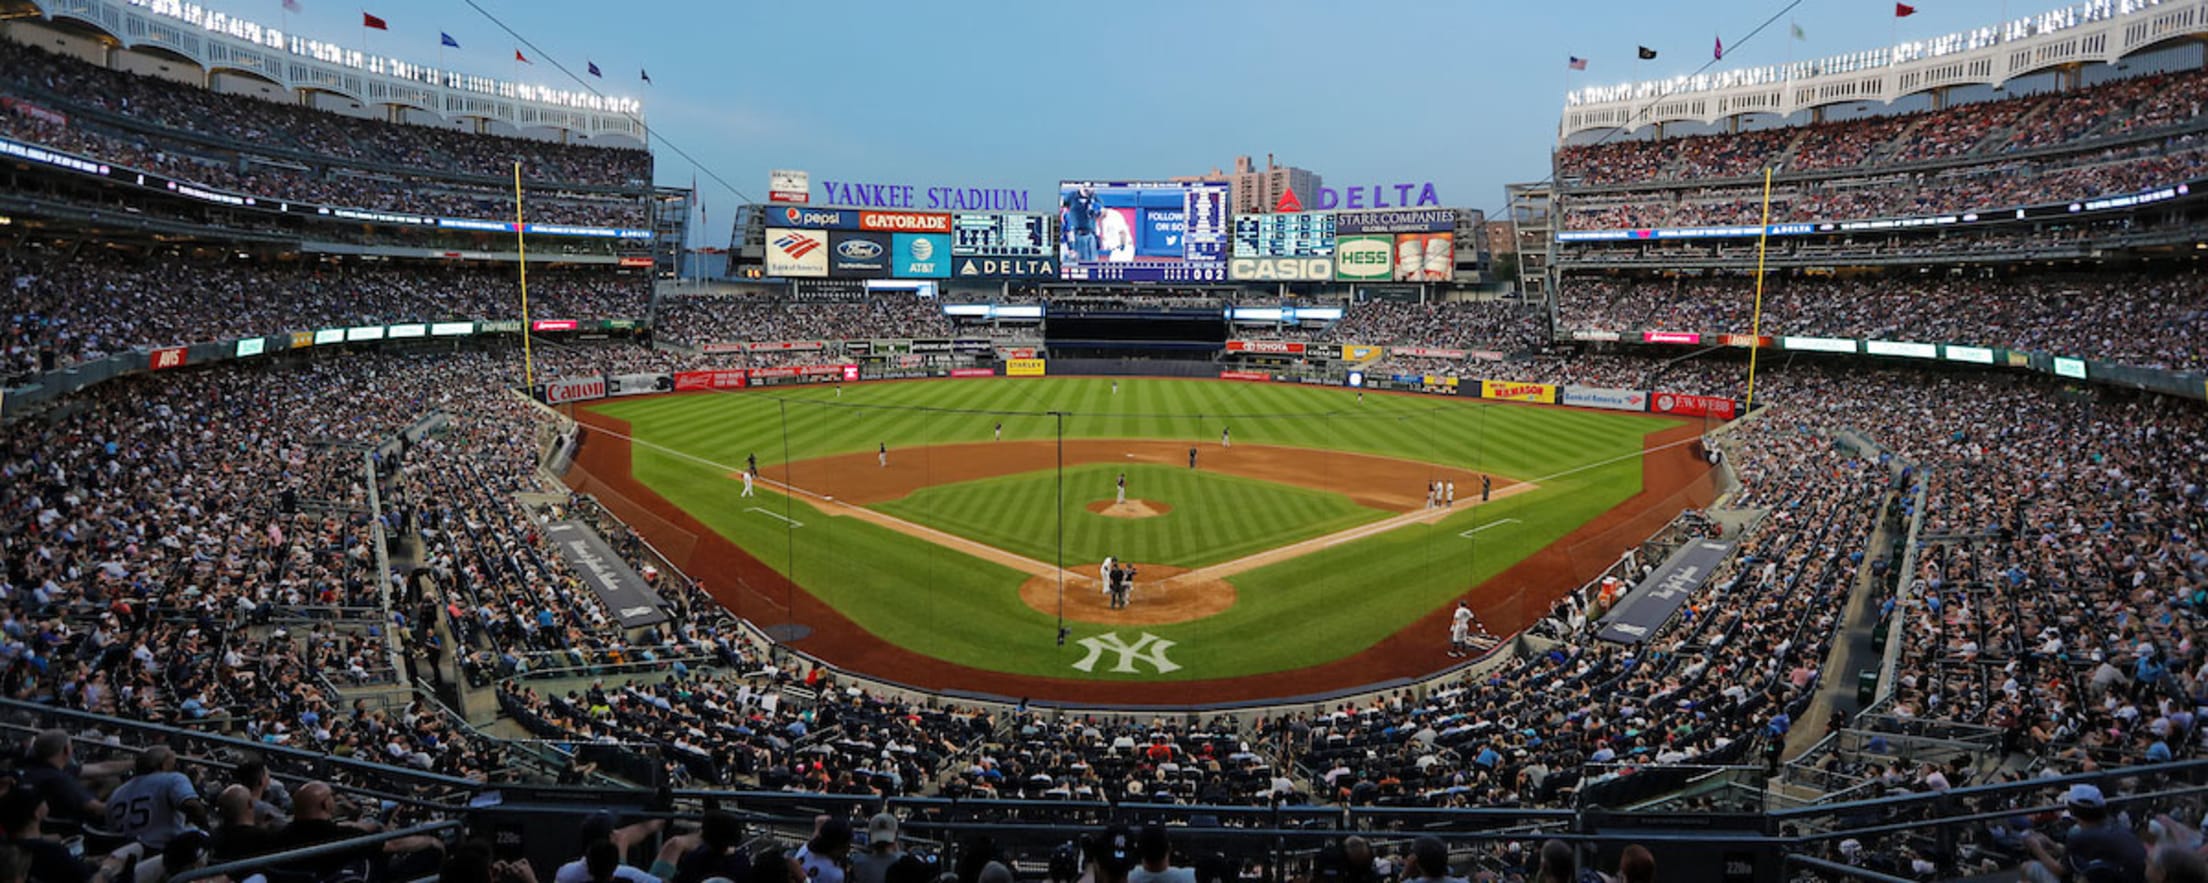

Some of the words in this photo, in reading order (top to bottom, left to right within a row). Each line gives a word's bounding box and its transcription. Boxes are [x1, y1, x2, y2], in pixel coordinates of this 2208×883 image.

[823, 181, 914, 209] YANKEE
[927, 186, 1030, 211] STADIUM
[1318, 182, 1440, 210] DELTA
[803, 210, 840, 226] pepsi
[864, 213, 947, 230] GATORADE
[1148, 212, 1184, 221] FOLLOW
[1339, 212, 1381, 227] STARR
[1382, 211, 1455, 226] COMPANIES
[1155, 222, 1169, 231] ON
[1362, 224, 1389, 233] GLOBAL
[1779, 224, 1811, 234] DELTA
[1341, 250, 1388, 265] HESS
[909, 262, 936, 274] AT&T
[983, 259, 1053, 276] DELTA
[1193, 269, 1202, 281] 0
[1204, 269, 1213, 281] 0
[1215, 269, 1224, 281] 2
[1231, 258, 1332, 280] CASIO
[1256, 342, 1289, 352] TOYOTA
[158, 350, 180, 368] AVIS
[547, 381, 605, 402] Canon
[1565, 392, 1580, 401] Bank
[1697, 399, 1730, 412] WEBB
[1071, 631, 1183, 675] NY
[107, 796, 150, 832] 25
